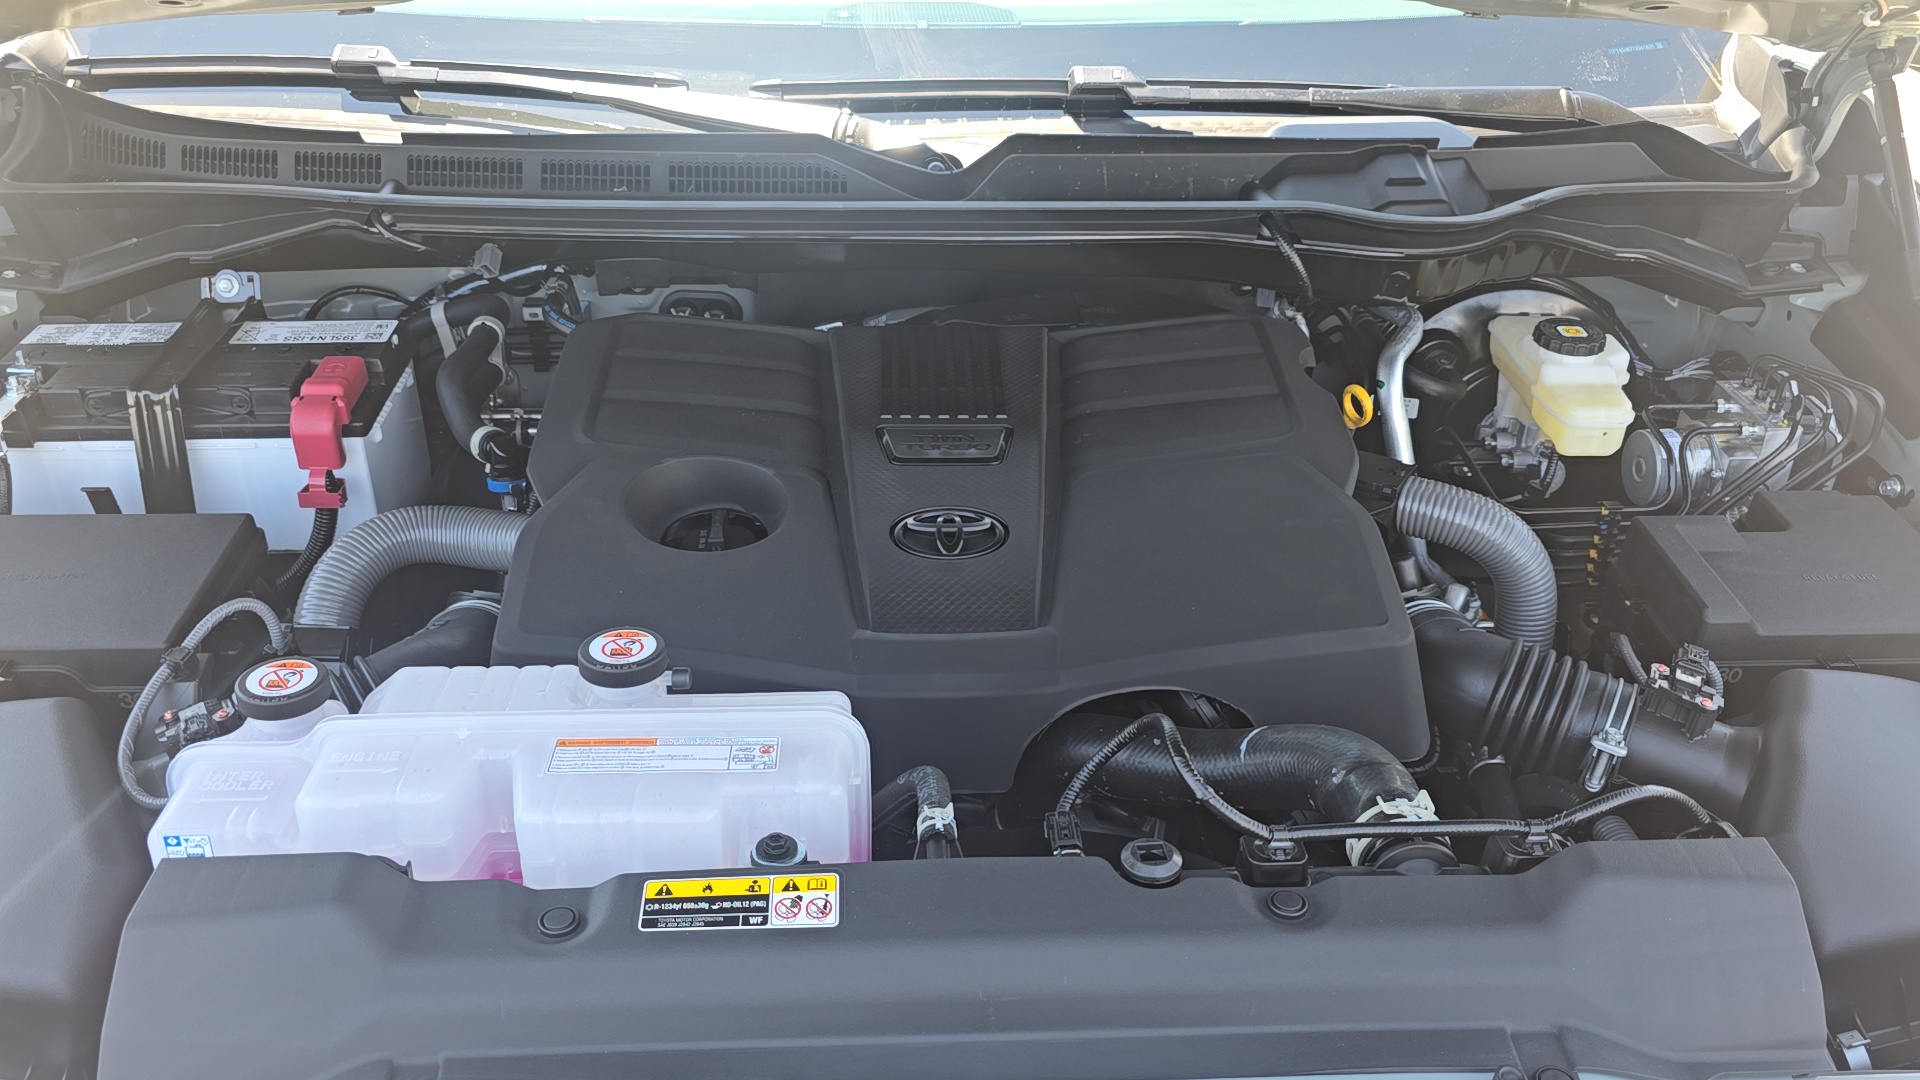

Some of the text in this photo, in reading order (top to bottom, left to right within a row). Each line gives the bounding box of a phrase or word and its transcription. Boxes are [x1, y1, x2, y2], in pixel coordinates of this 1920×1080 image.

[911, 434, 975, 442] TWIN
[900, 442, 992, 451] TURBO
[328, 750, 402, 763] ENGINE
[198, 779, 275, 792] COOLER
[749, 916, 764, 924] WF
